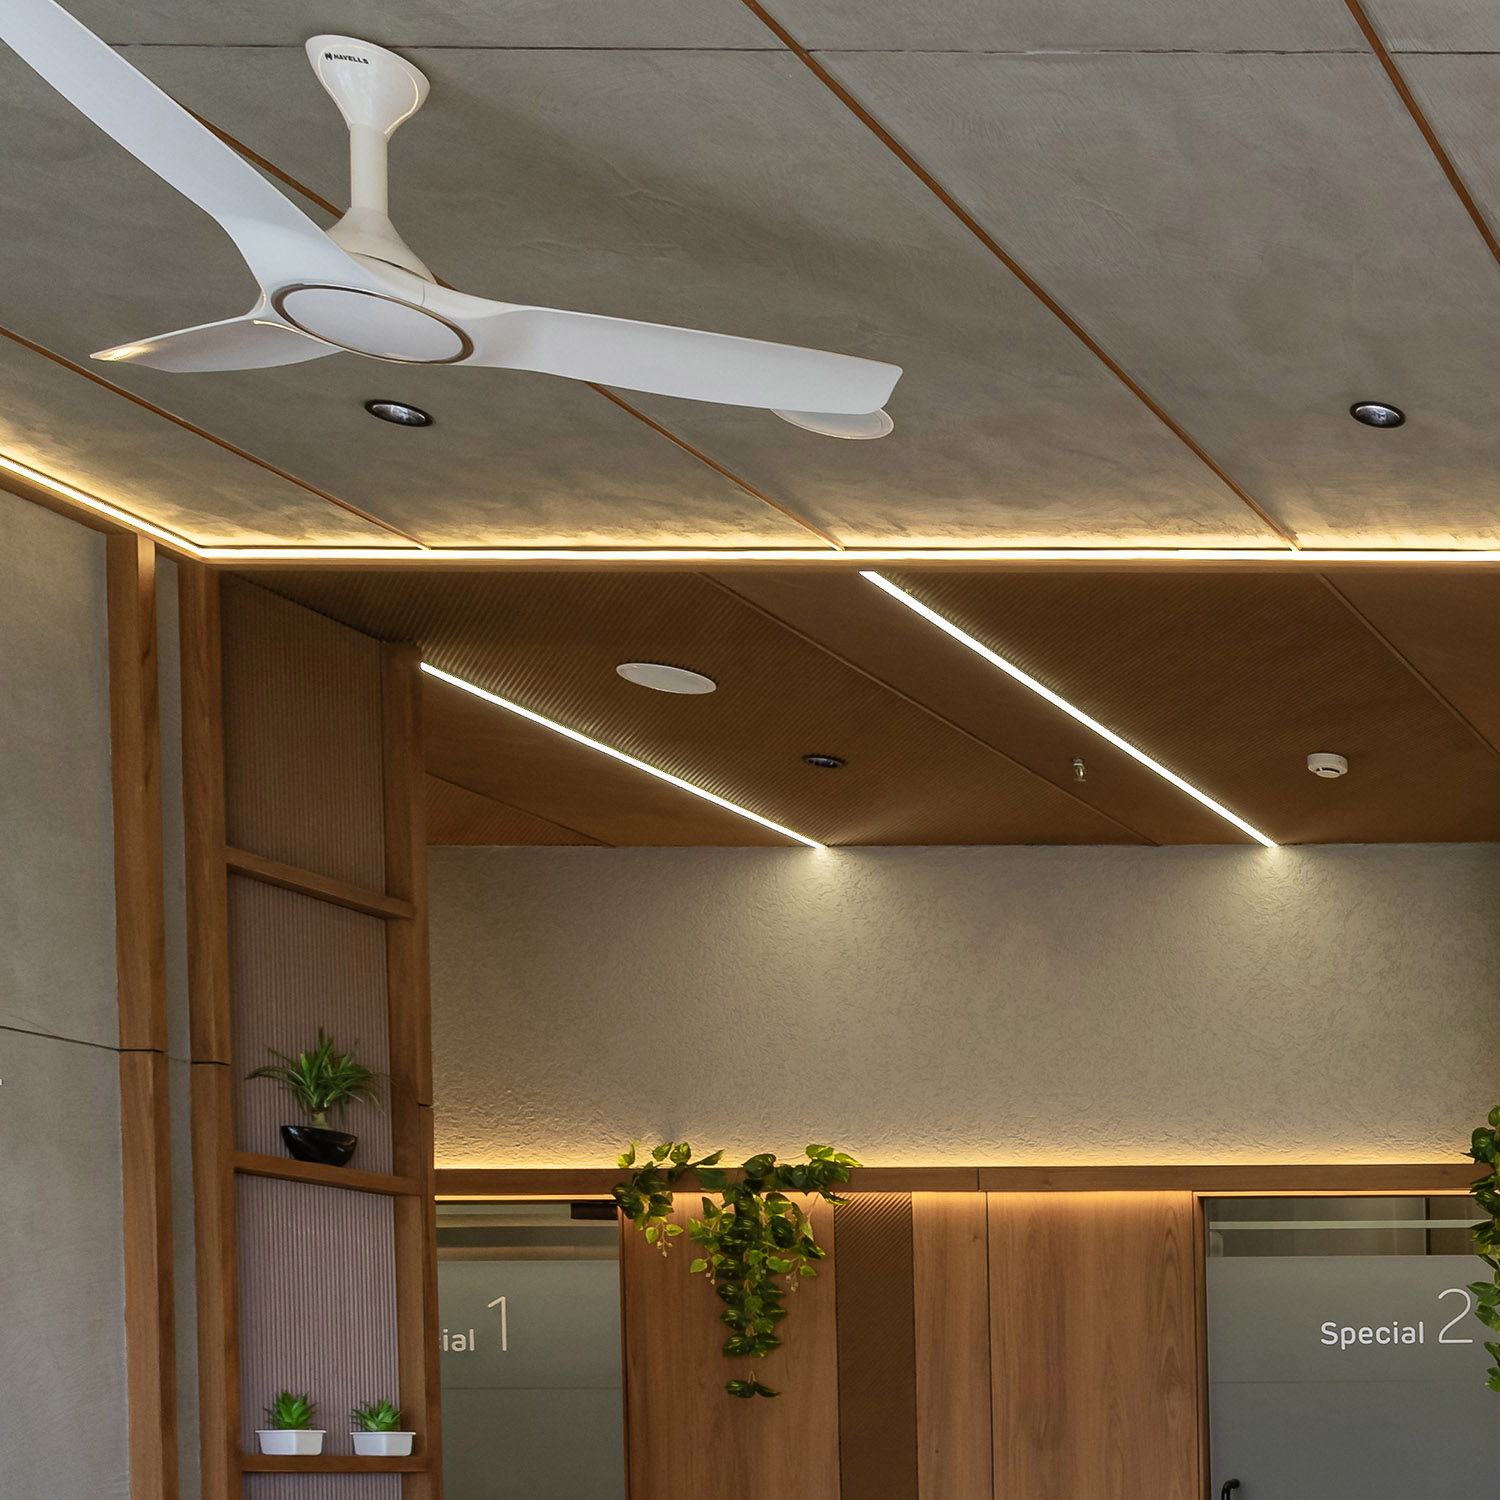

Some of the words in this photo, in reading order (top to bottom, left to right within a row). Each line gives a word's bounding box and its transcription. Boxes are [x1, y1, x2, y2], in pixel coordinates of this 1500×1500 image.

[439, 1328, 476, 1352] ial
[487, 1296, 507, 1352] 1
[1320, 1321, 1425, 1350] Special
[1437, 1288, 1474, 1344] 2
